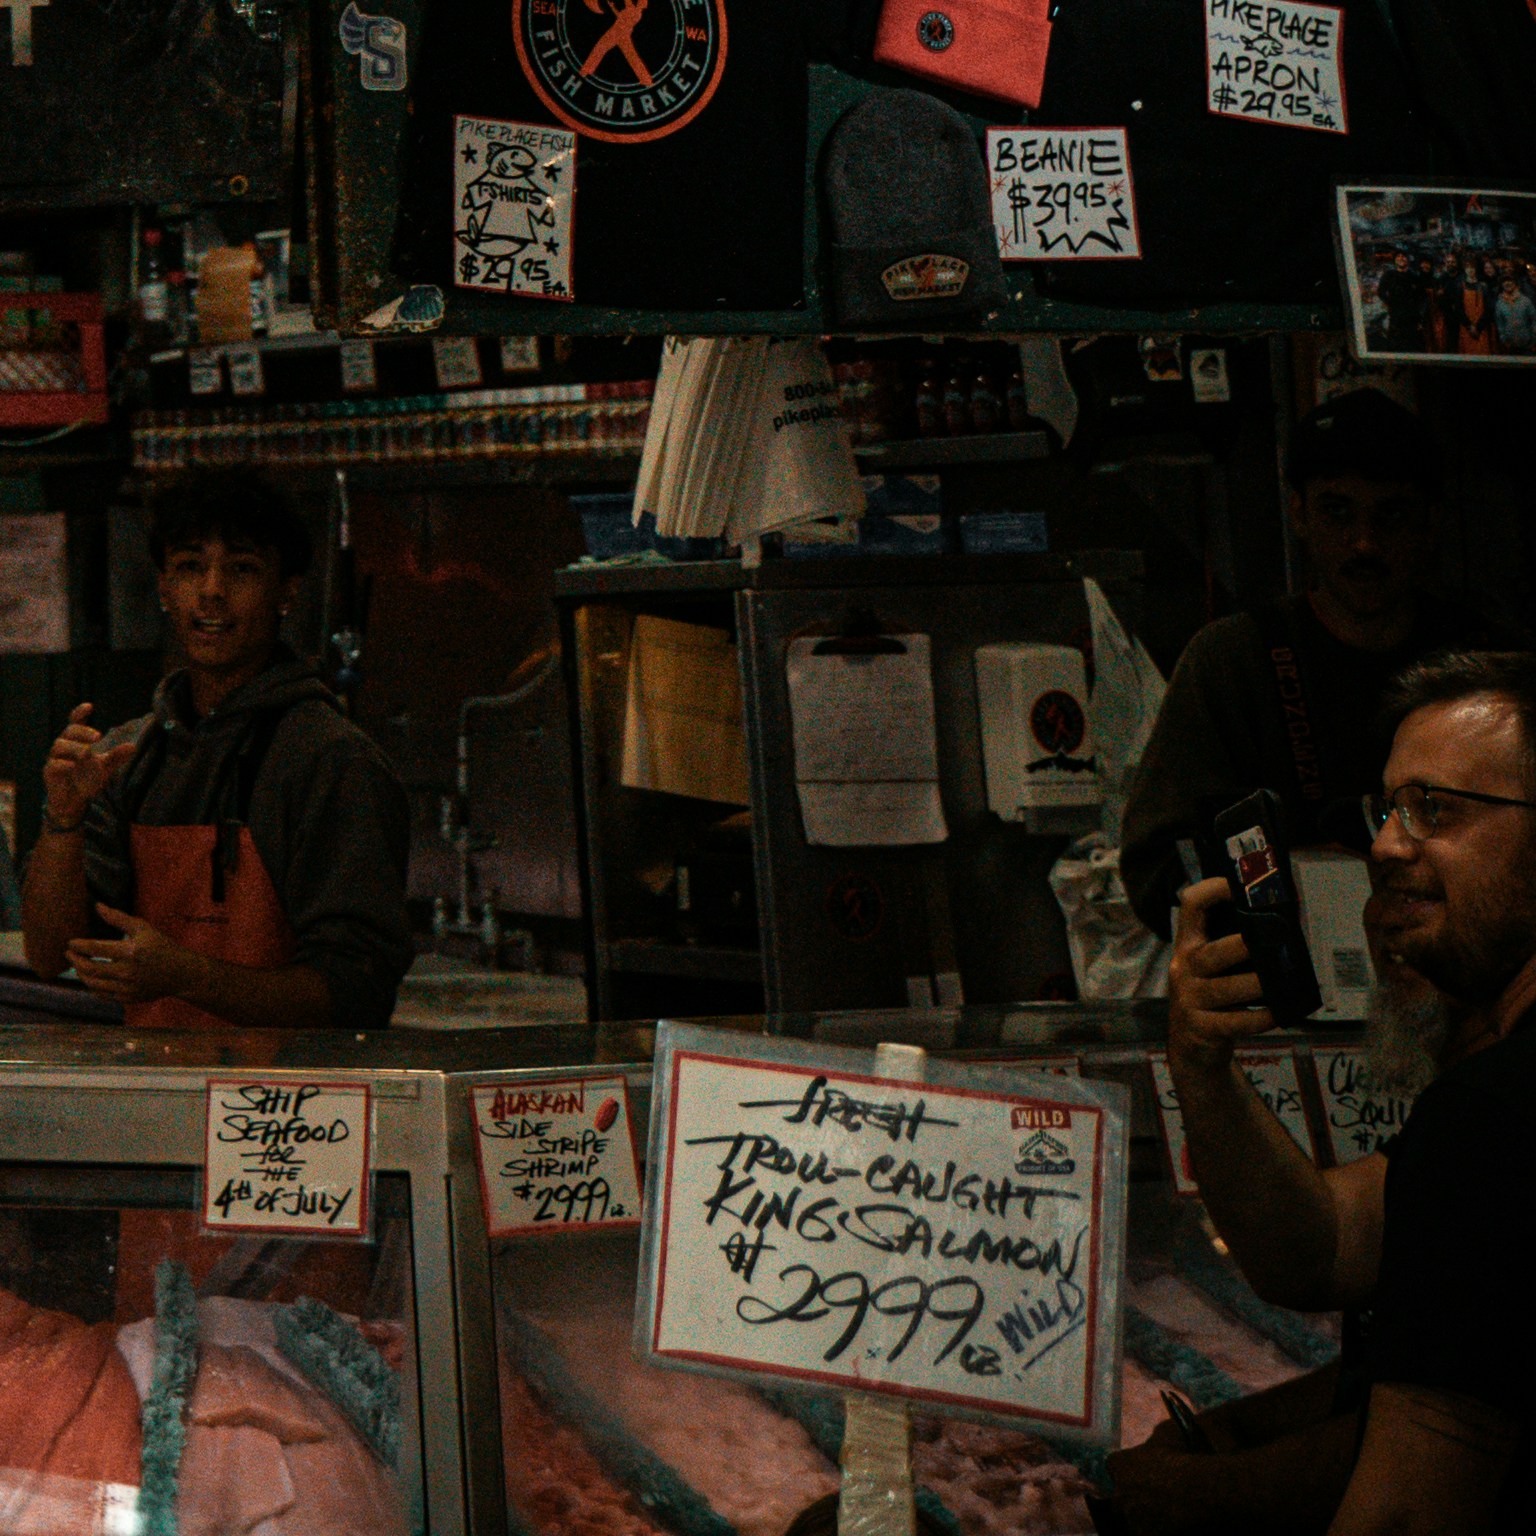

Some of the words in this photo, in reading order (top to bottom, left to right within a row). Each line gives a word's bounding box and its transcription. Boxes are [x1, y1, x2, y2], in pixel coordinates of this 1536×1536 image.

[532, 0, 557, 16] SEA
[685, 26, 709, 43] WA
[1266, 7, 1332, 47] PLACE
[536, 28, 583, 97] FISH
[594, 53, 701, 118] MARKET
[1212, 52, 1320, 93] APRON
[1213, 82, 1312, 118] $29.95
[460, 119, 497, 140] PIKE
[500, 125, 539, 148] PLACE
[539, 133, 574, 152] FISH
[994, 137, 1122, 176] BEANIE
[476, 181, 542, 206] T-SHIRTS
[1007, 177, 1107, 244] $39.95
[459, 252, 549, 295] $29.95
[221, 1084, 321, 1117] SHIP
[488, 1080, 585, 1121] ALASKAN
[1014, 1109, 1066, 1128] WILD
[217, 1114, 350, 1145] SEAFOOD
[479, 1118, 554, 1139] SIDE
[523, 1129, 611, 1156] STRIPE
[499, 1155, 599, 1178] SHRIMP
[684, 1131, 1081, 1220] TROLL-CAUGHT
[282, 1184, 352, 1225] JULY
[704, 1168, 839, 1243] KING
[837, 1204, 1091, 1282] SALMON
